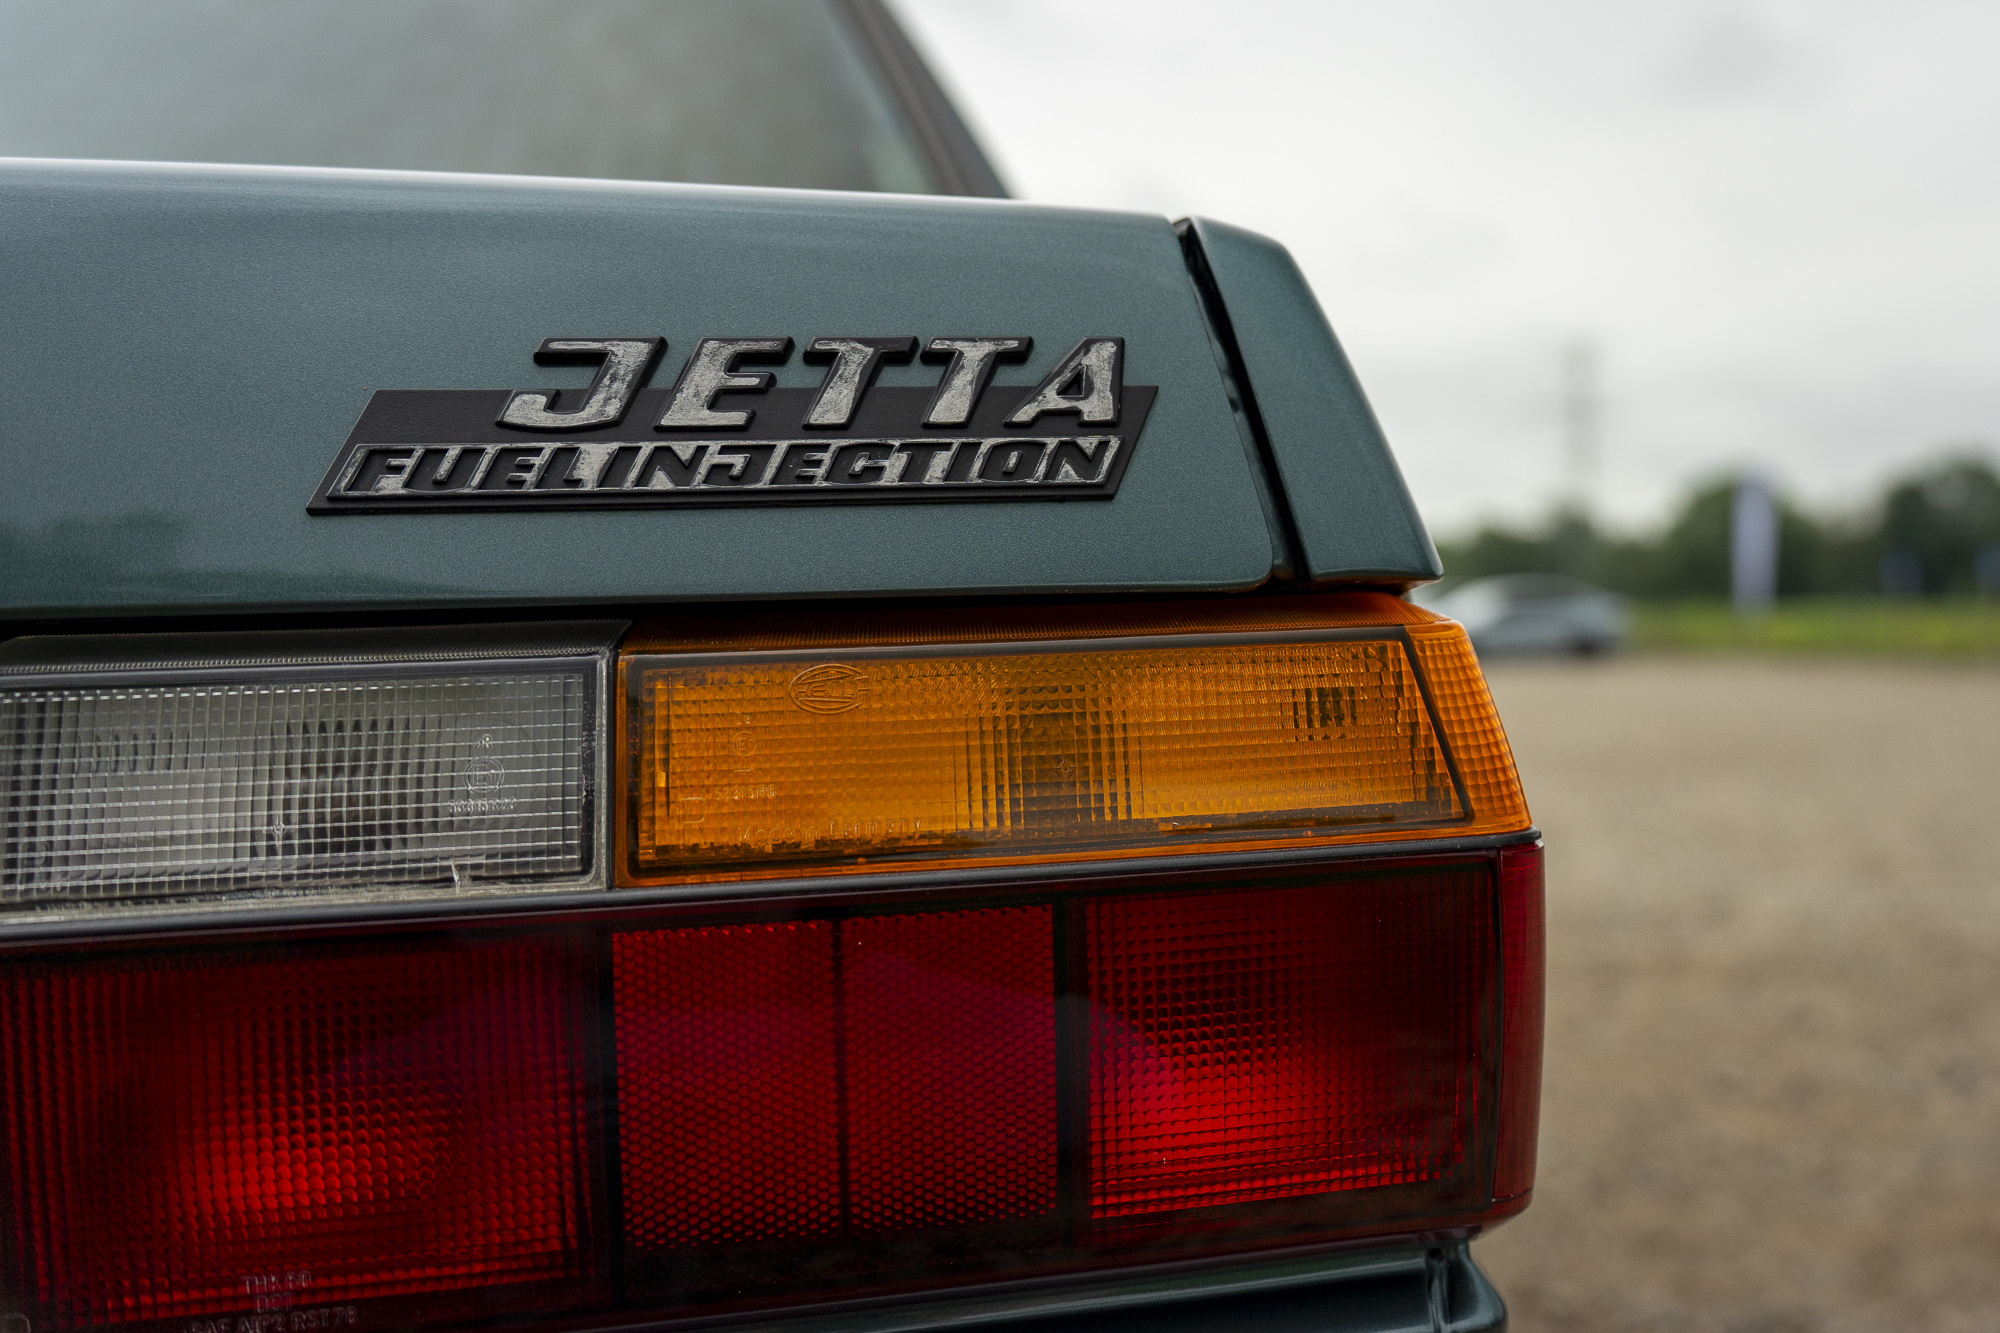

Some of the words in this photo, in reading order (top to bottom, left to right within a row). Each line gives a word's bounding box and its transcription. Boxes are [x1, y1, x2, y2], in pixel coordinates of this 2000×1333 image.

[495, 336, 1125, 433] JETTA
[737, 823, 796, 846] Made
[828, 817, 921, 839] Germany
[255, 1291, 295, 1314] DOT
